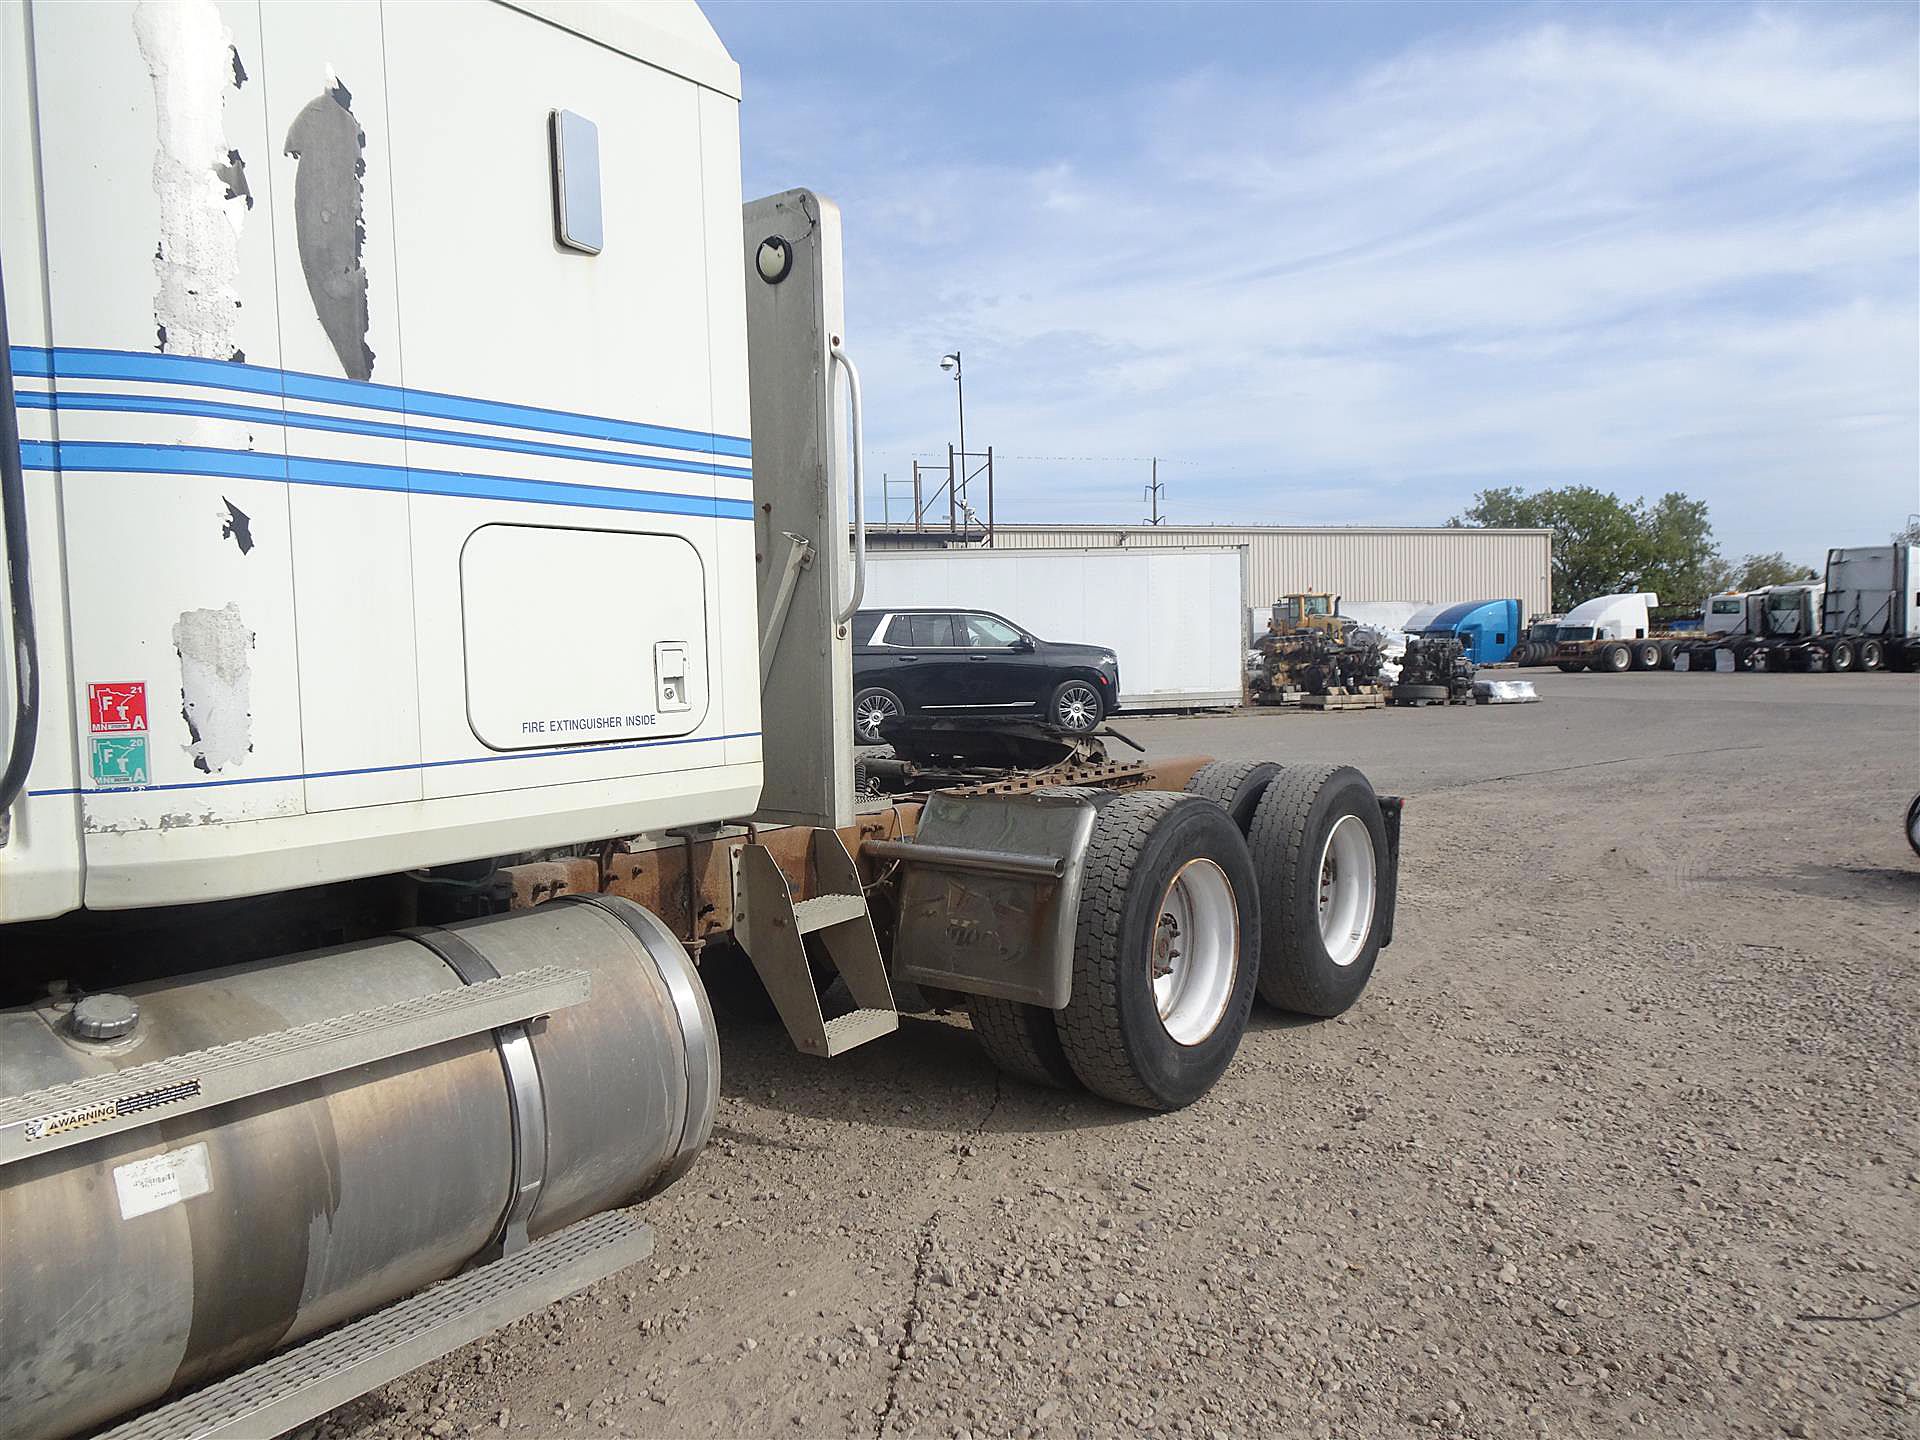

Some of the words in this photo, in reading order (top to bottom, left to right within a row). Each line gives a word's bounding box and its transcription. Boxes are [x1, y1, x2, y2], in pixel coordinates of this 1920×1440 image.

[130, 686, 143, 694] 21
[522, 721, 545, 734] FIRE
[549, 716, 622, 732] EXTINGUISHER
[625, 714, 656, 727] INSIDE
[58, 1106, 115, 1127] WARNING
